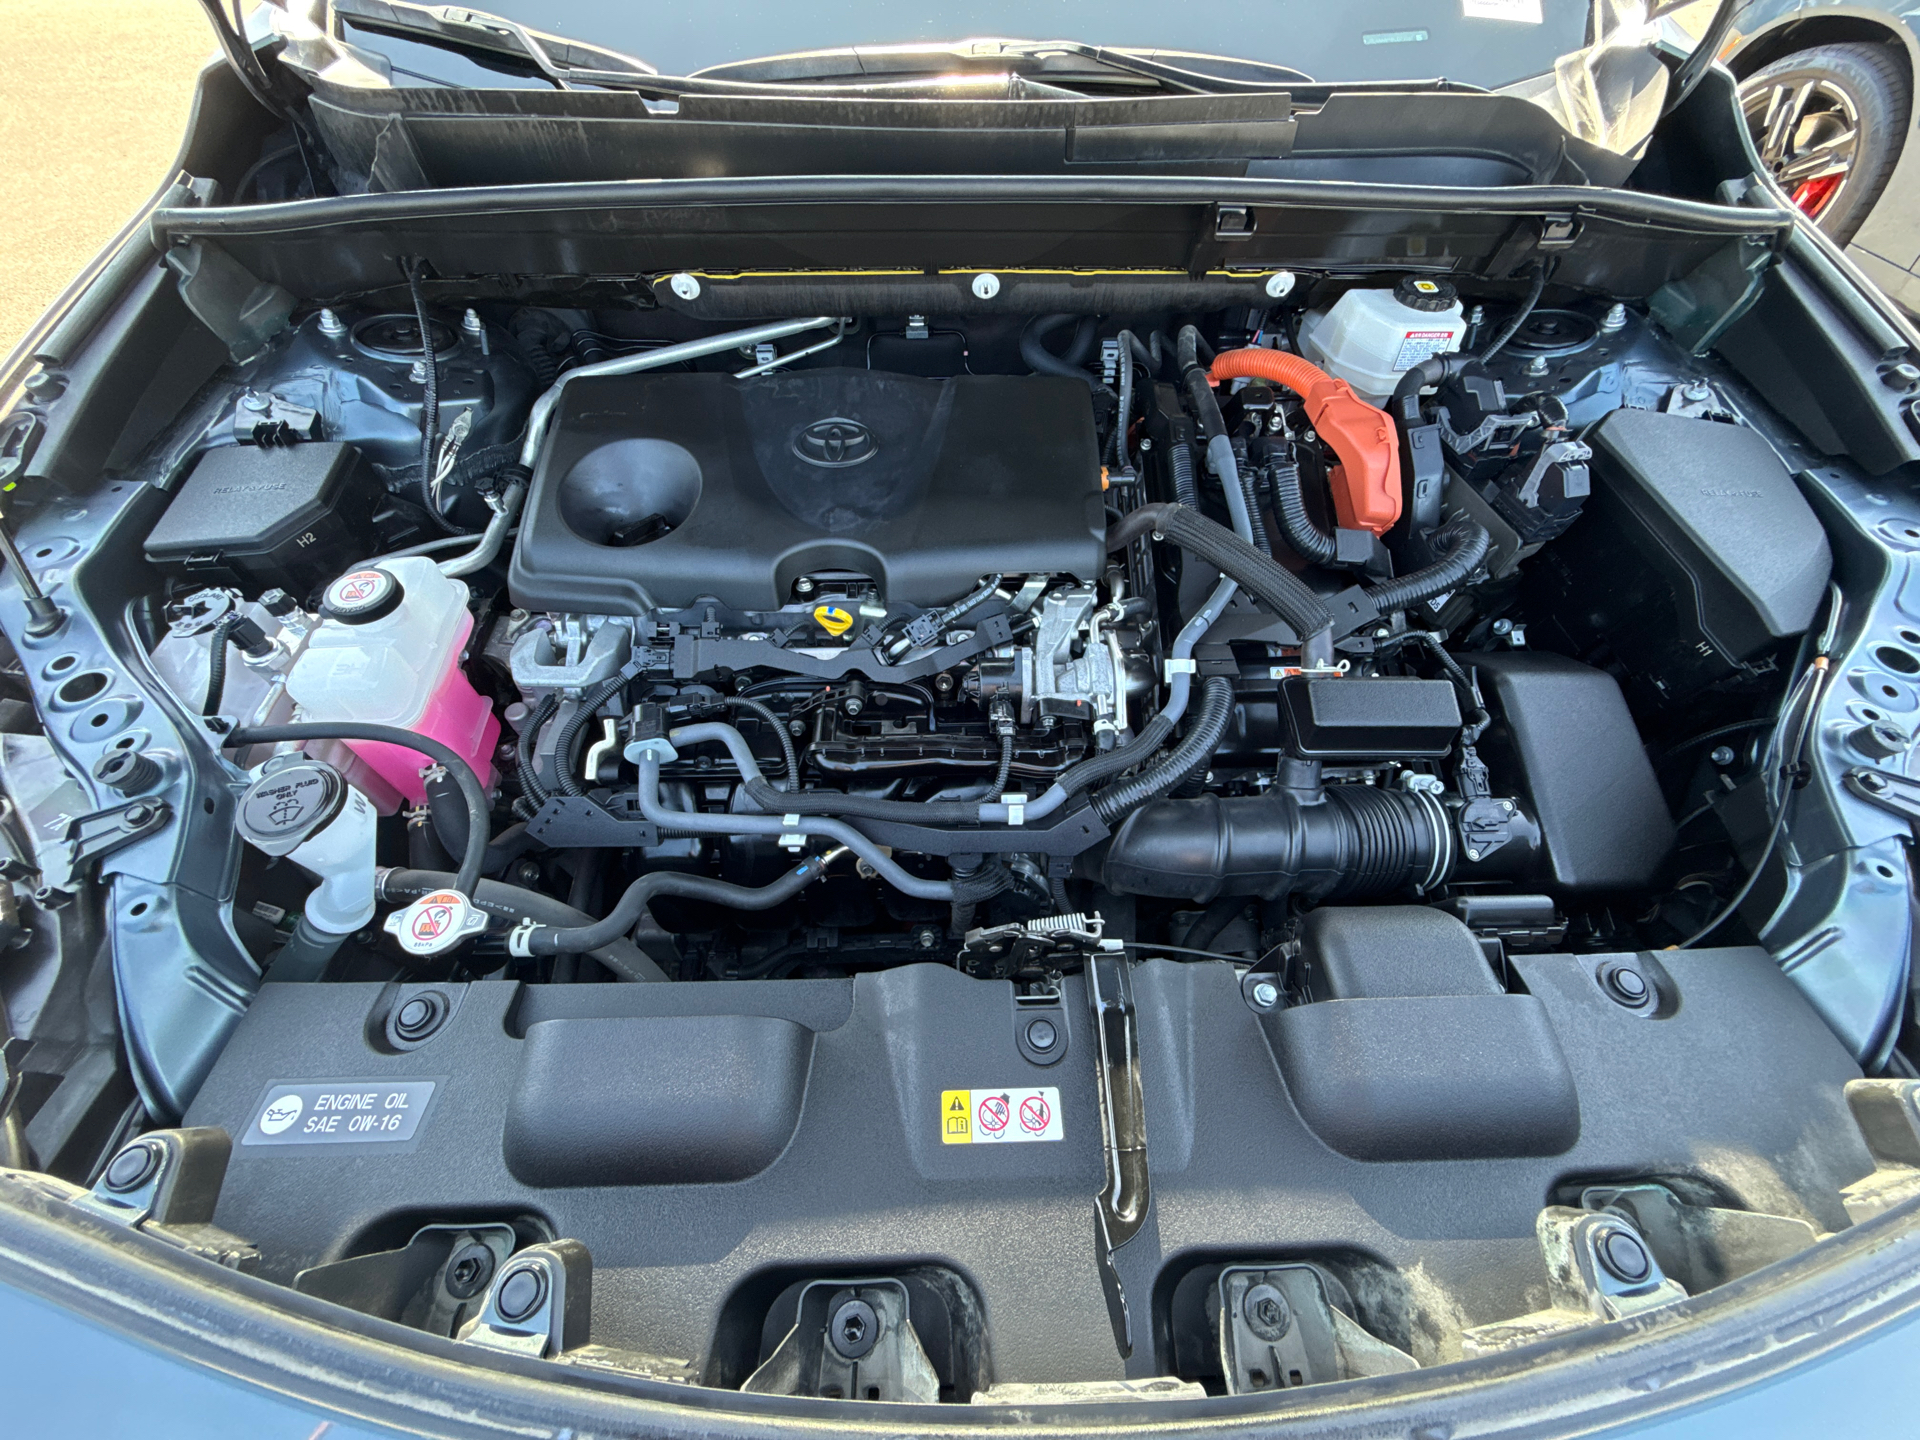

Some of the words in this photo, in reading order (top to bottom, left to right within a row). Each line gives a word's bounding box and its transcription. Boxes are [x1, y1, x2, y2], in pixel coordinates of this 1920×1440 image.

[296, 532, 317, 548] H2
[187, 590, 226, 603] COOLANT
[1695, 641, 1714, 657] H1
[255, 784, 292, 799] WASHER
[295, 778, 319, 789] FLUID
[275, 789, 298, 800] ONLY
[313, 1093, 378, 1111] ENGINE
[384, 1092, 410, 1109] OIL
[303, 1115, 342, 1133] SAE
[348, 1114, 402, 1132] 0W-16
